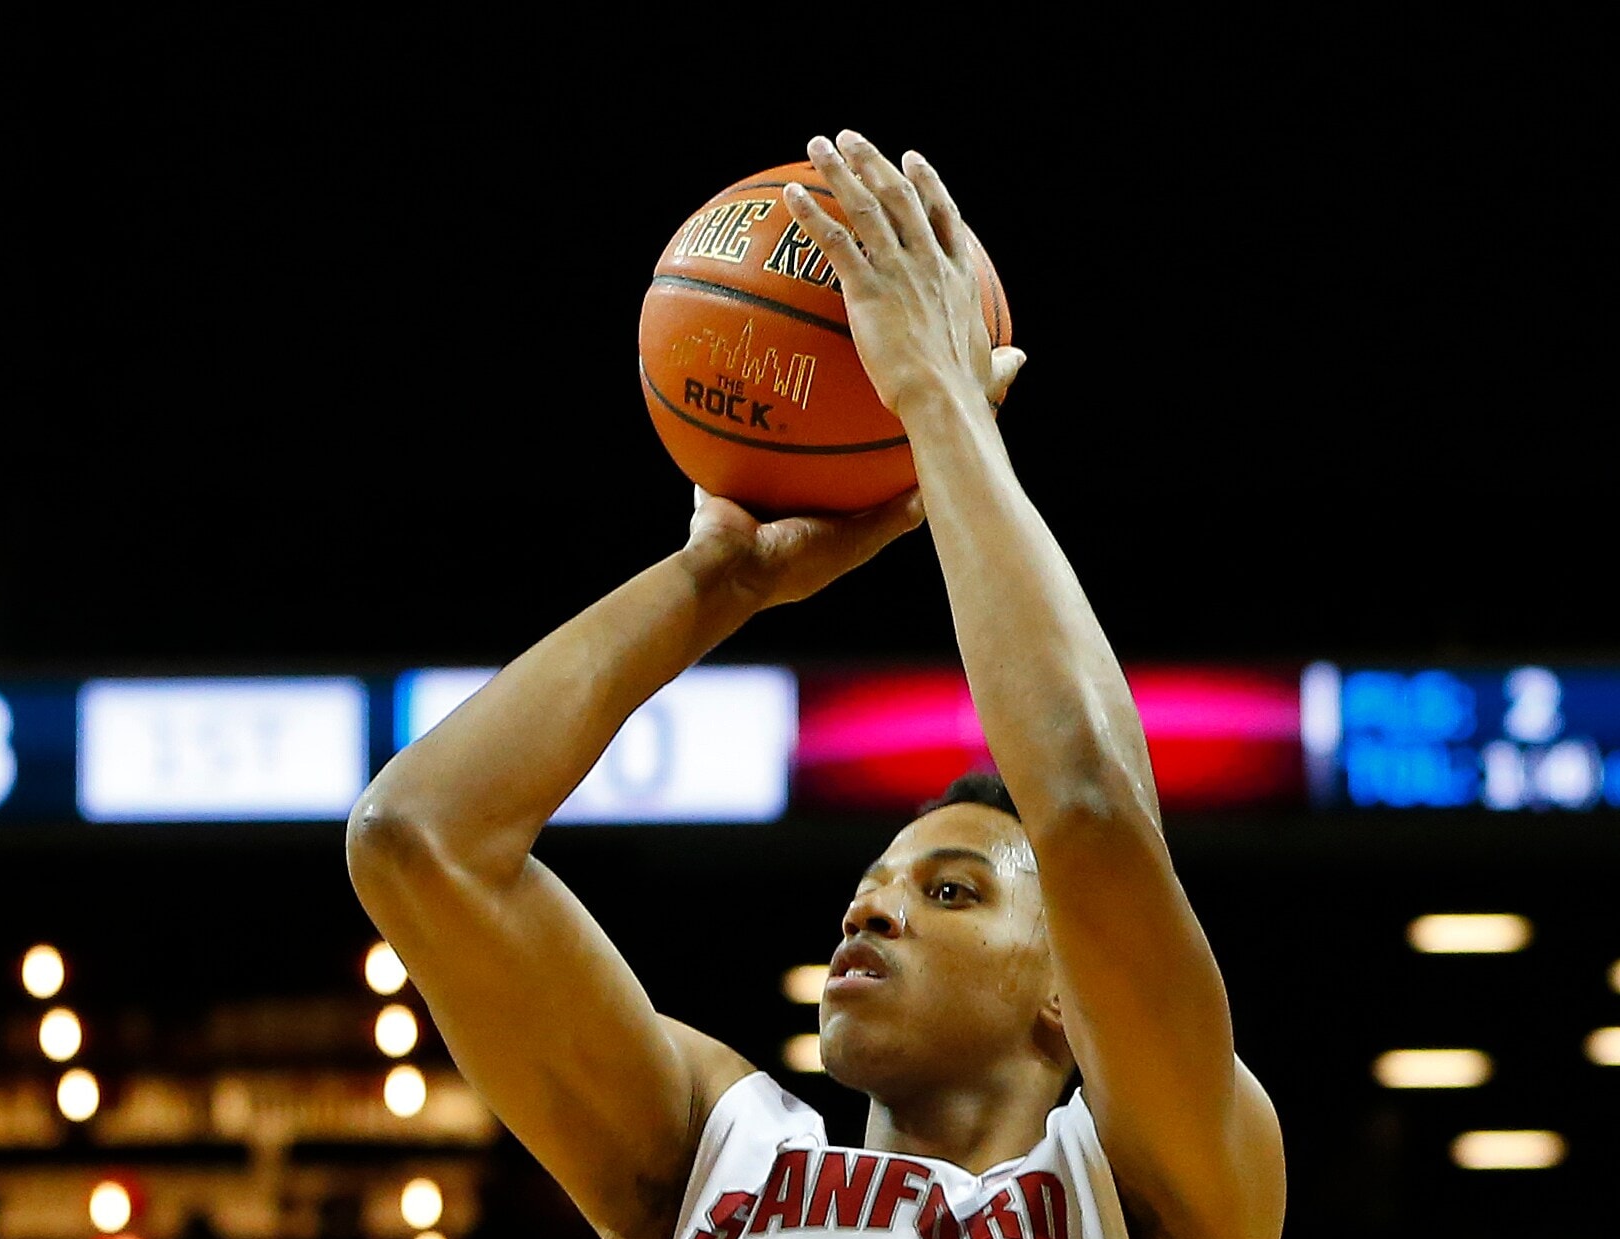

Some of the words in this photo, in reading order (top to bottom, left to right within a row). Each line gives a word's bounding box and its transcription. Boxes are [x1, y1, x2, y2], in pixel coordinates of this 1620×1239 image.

[674, 199, 778, 263] THE
[684, 377, 774, 431] ROCK
[716, 373, 745, 397] THE
